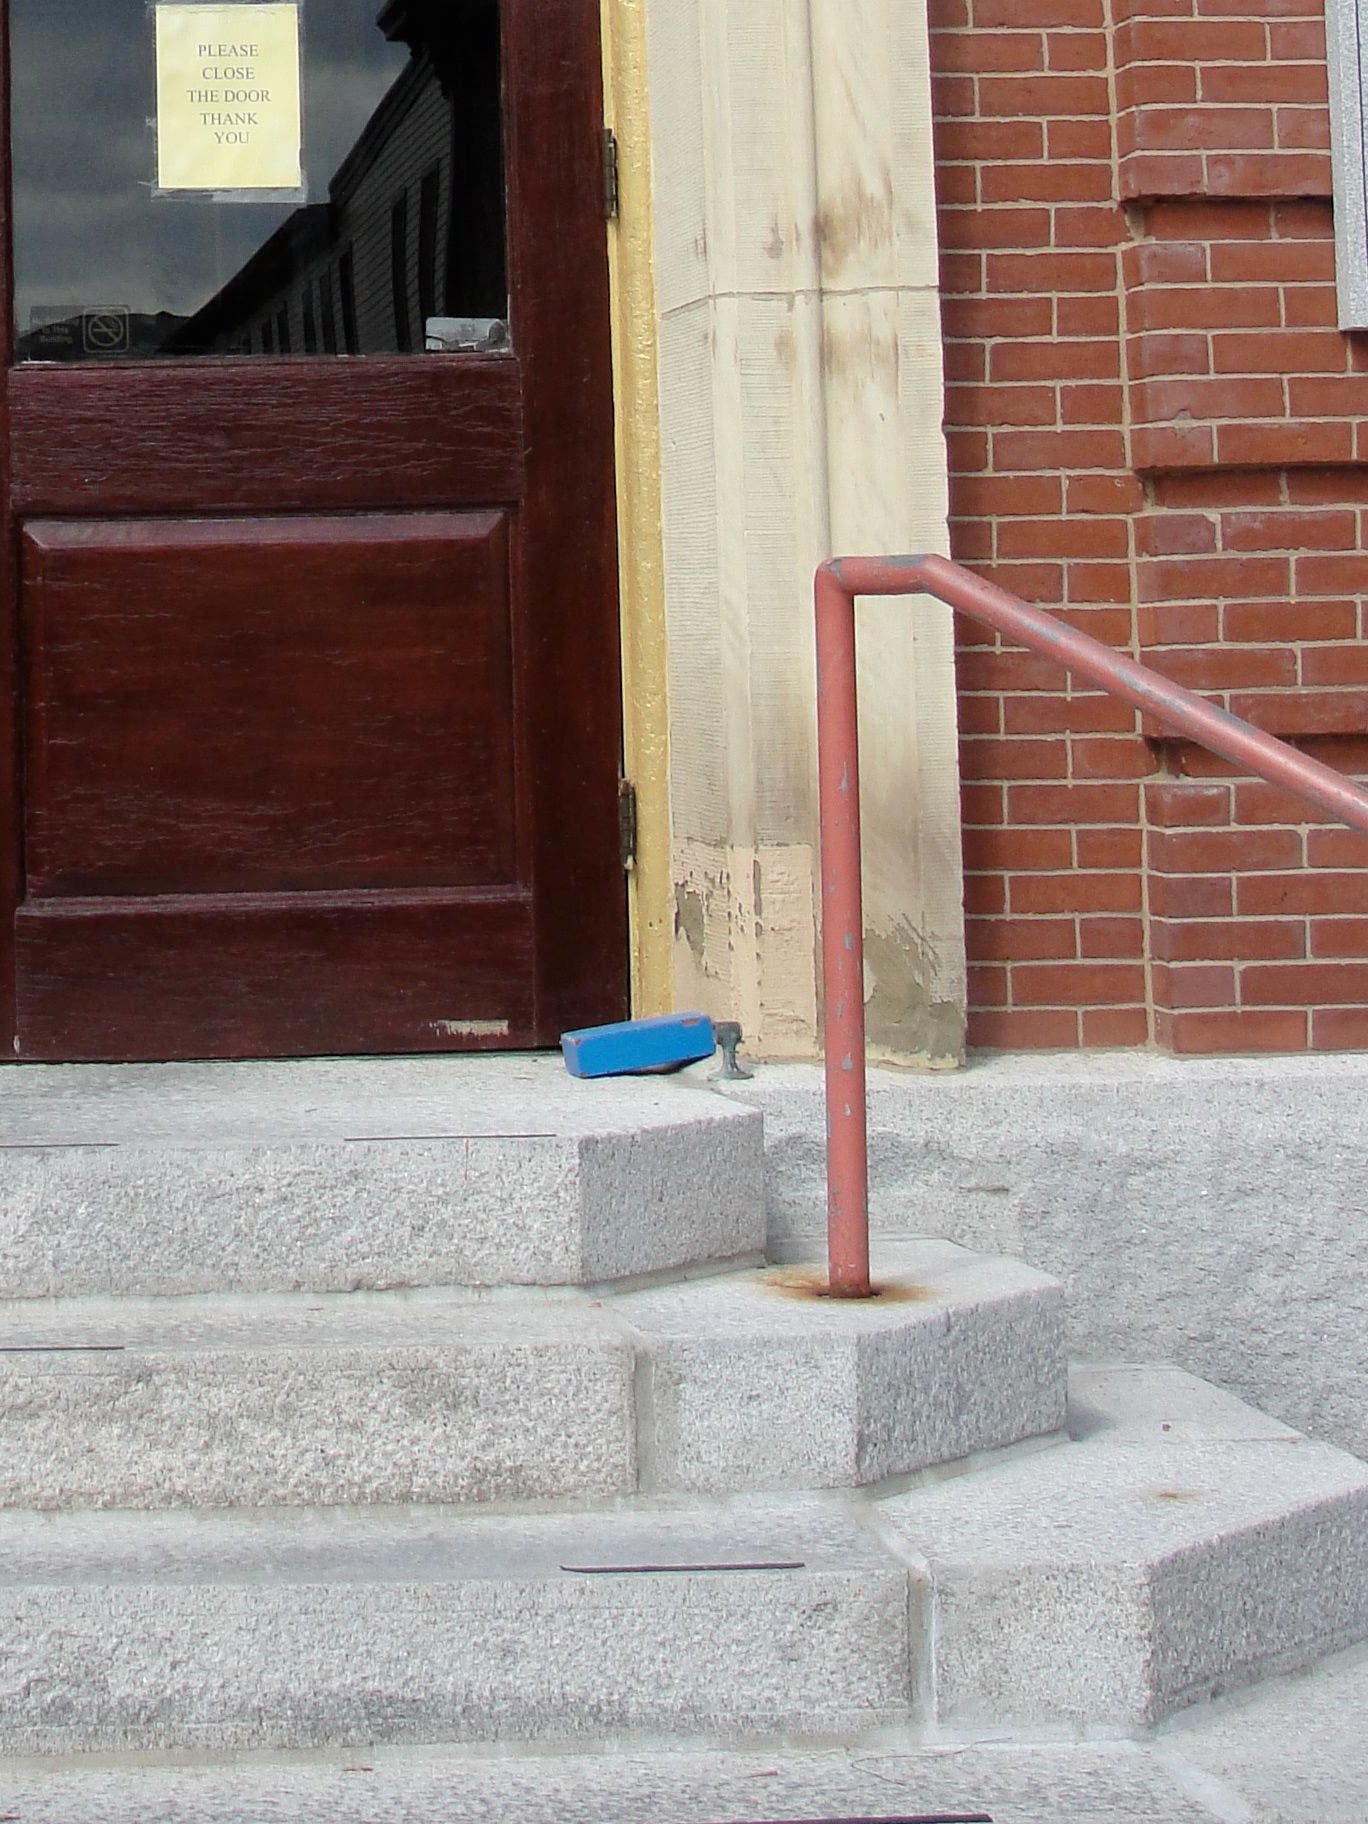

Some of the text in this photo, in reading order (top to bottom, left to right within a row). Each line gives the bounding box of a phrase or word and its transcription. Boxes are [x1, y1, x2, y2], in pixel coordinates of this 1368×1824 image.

[198, 44, 259, 57] PLEASE
[202, 67, 255, 80] CLOSE
[186, 90, 272, 103] THE DOOR
[200, 112, 258, 125] THANK
[213, 131, 249, 144] YOU
